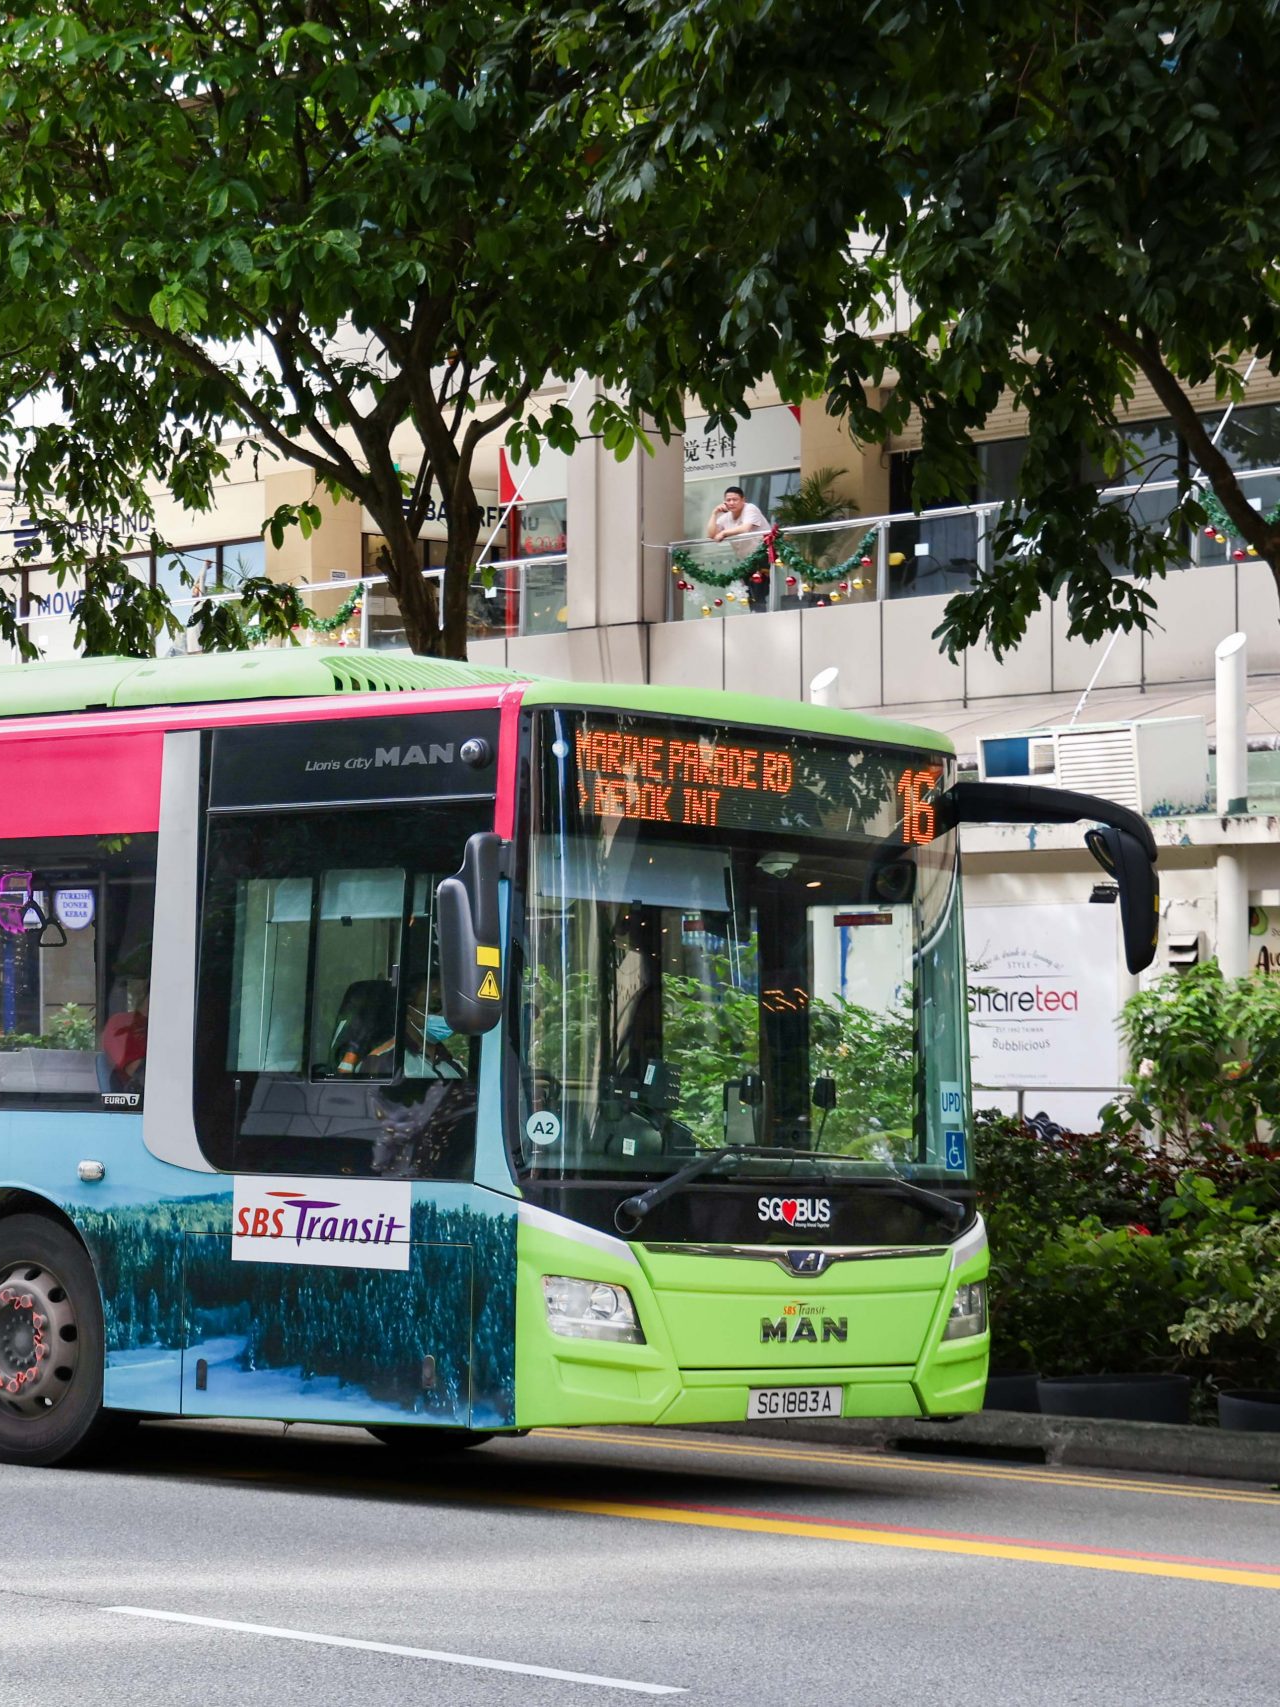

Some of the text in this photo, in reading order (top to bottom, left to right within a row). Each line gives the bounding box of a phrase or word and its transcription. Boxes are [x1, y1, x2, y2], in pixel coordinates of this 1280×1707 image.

[374, 742, 455, 768] MAN
[575, 730, 793, 793] MARINE PARADE RD
[593, 777, 721, 827] BEDOK INT
[897, 767, 936, 846] 16
[992, 1038, 1052, 1052] Bubblicious
[104, 1096, 126, 1105] EURO
[941, 1092, 961, 1112] UPD
[532, 1121, 555, 1135] A2
[235, 1199, 406, 1248] SBS Transit
[783, 1302, 826, 1317] SBS Transit
[760, 1316, 849, 1344] MAN
[757, 1390, 833, 1415] SG1883A
